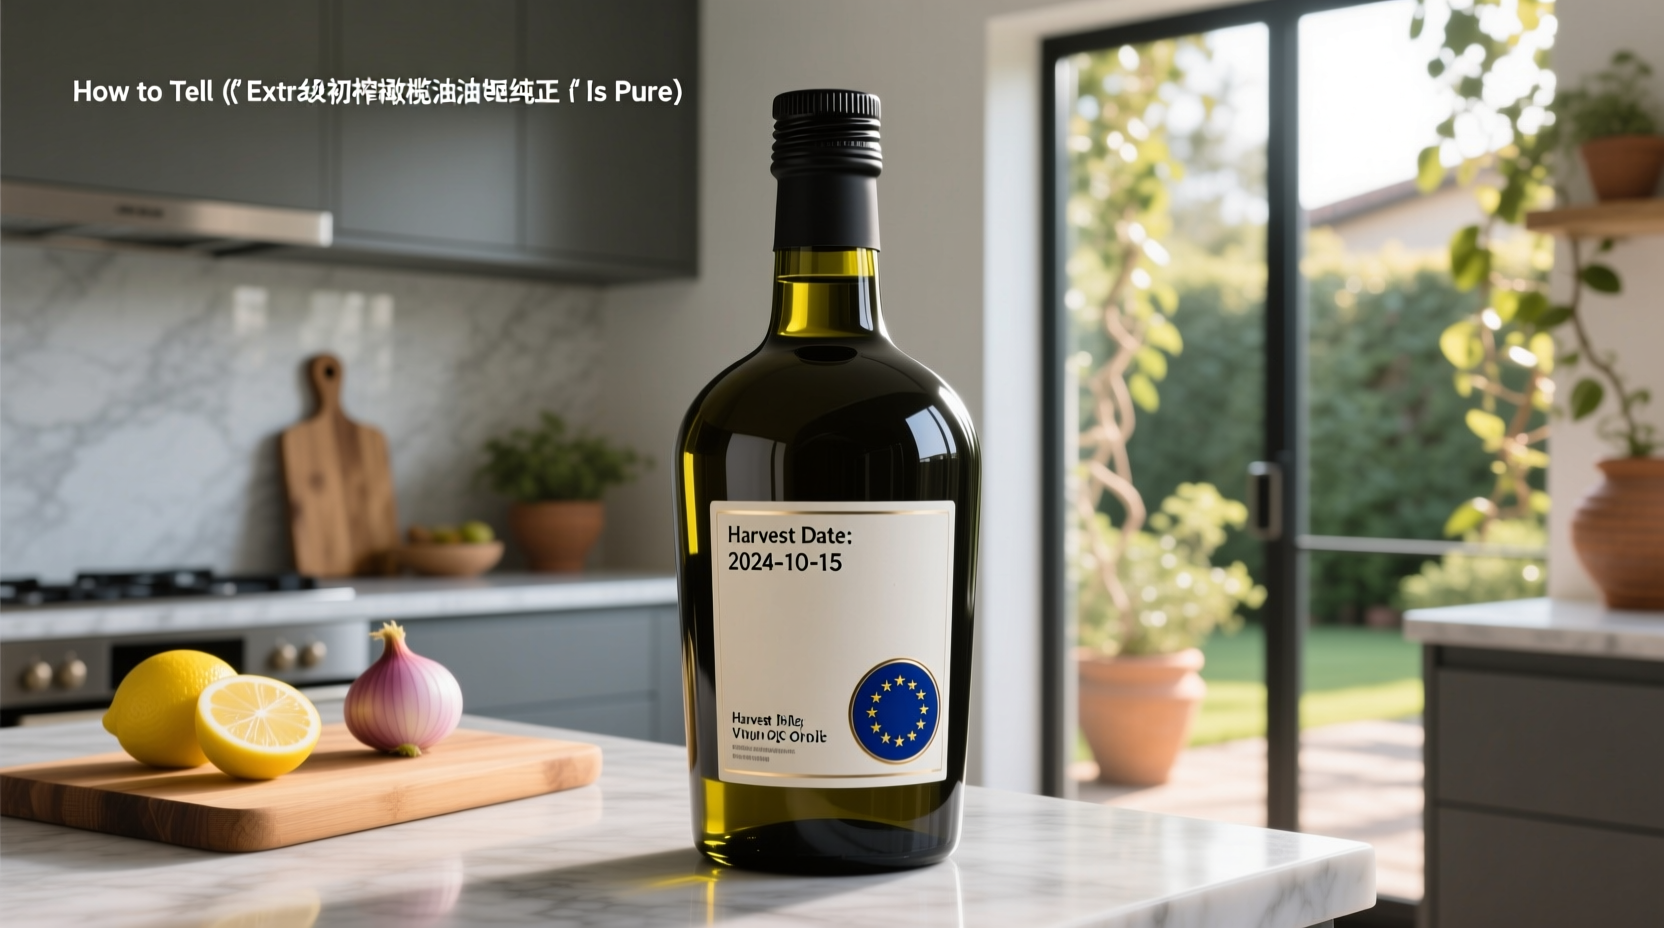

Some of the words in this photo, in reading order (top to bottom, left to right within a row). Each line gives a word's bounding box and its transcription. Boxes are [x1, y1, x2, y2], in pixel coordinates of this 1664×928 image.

[728, 525, 796, 544] Harvest
[801, 526, 852, 545] Date:
[728, 551, 843, 572] 2024-10-15
[732, 711, 772, 727] Harvest
